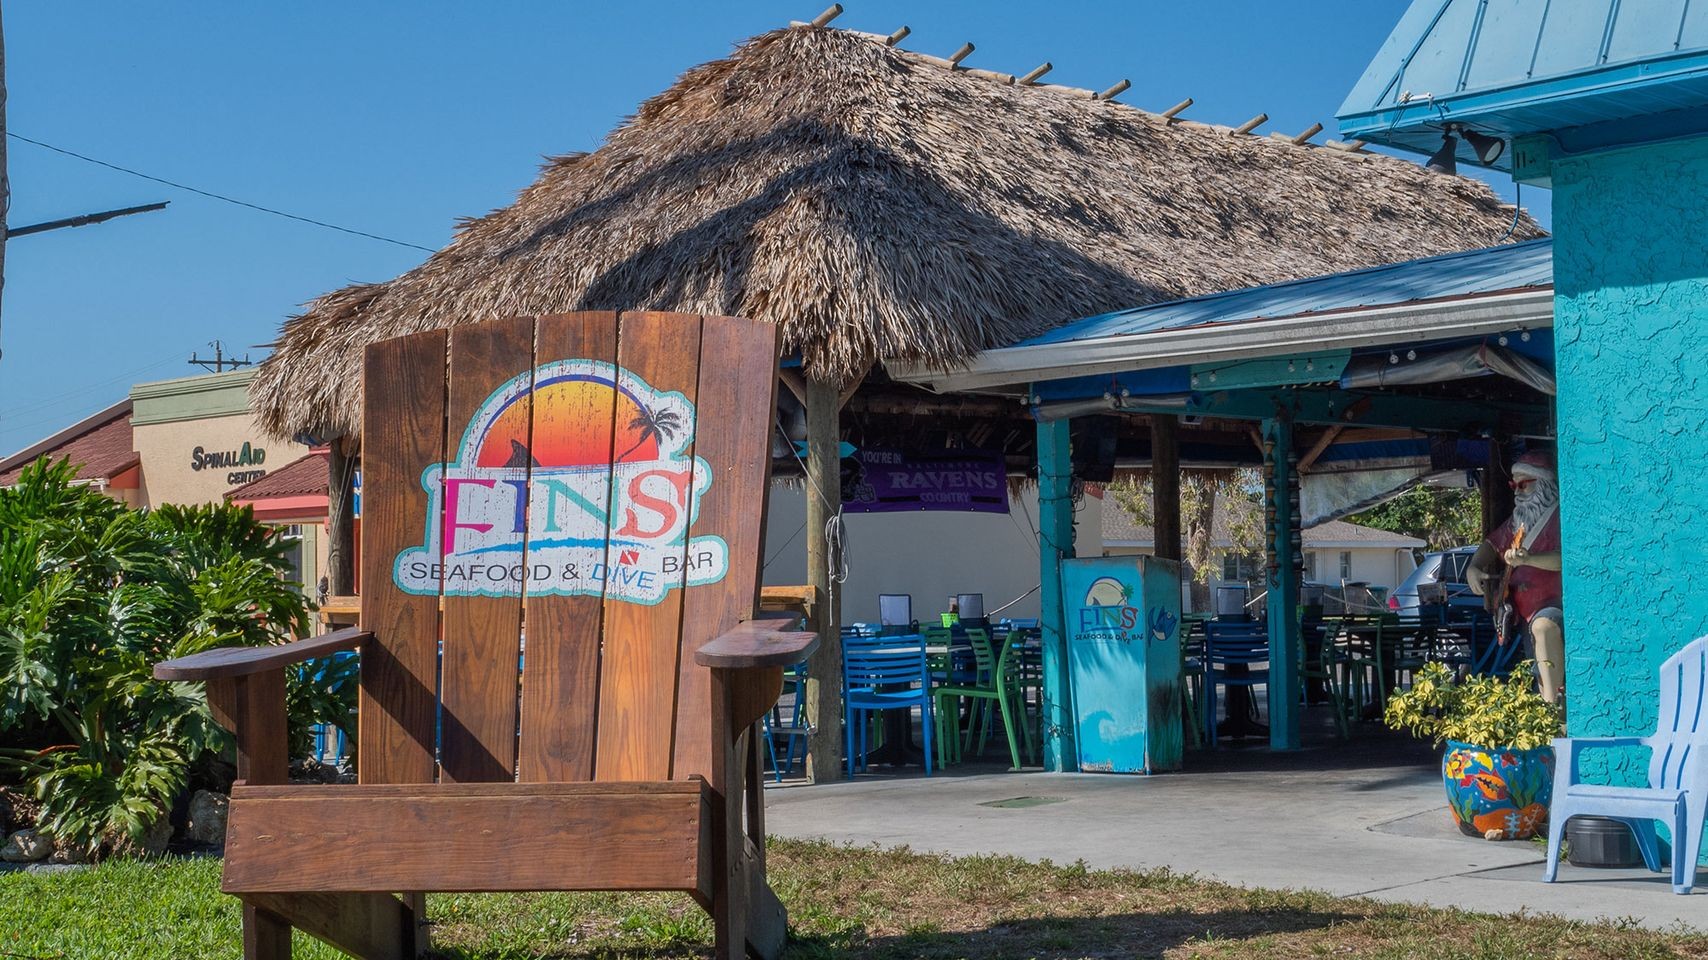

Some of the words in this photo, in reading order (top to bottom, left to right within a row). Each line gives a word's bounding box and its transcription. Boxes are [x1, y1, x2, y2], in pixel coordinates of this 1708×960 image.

[862, 452, 891, 464] YOU'RE
[893, 454, 902, 464] IN
[888, 471, 998, 489] RAVENS
[920, 492, 969, 503] COUNTRY
[439, 470, 696, 556] FINS
[409, 562, 551, 582] SEAFOOD
[562, 564, 580, 580] &
[591, 563, 657, 589] DIVE
[662, 551, 714, 574] BAR
[1079, 607, 1139, 633] FINS
